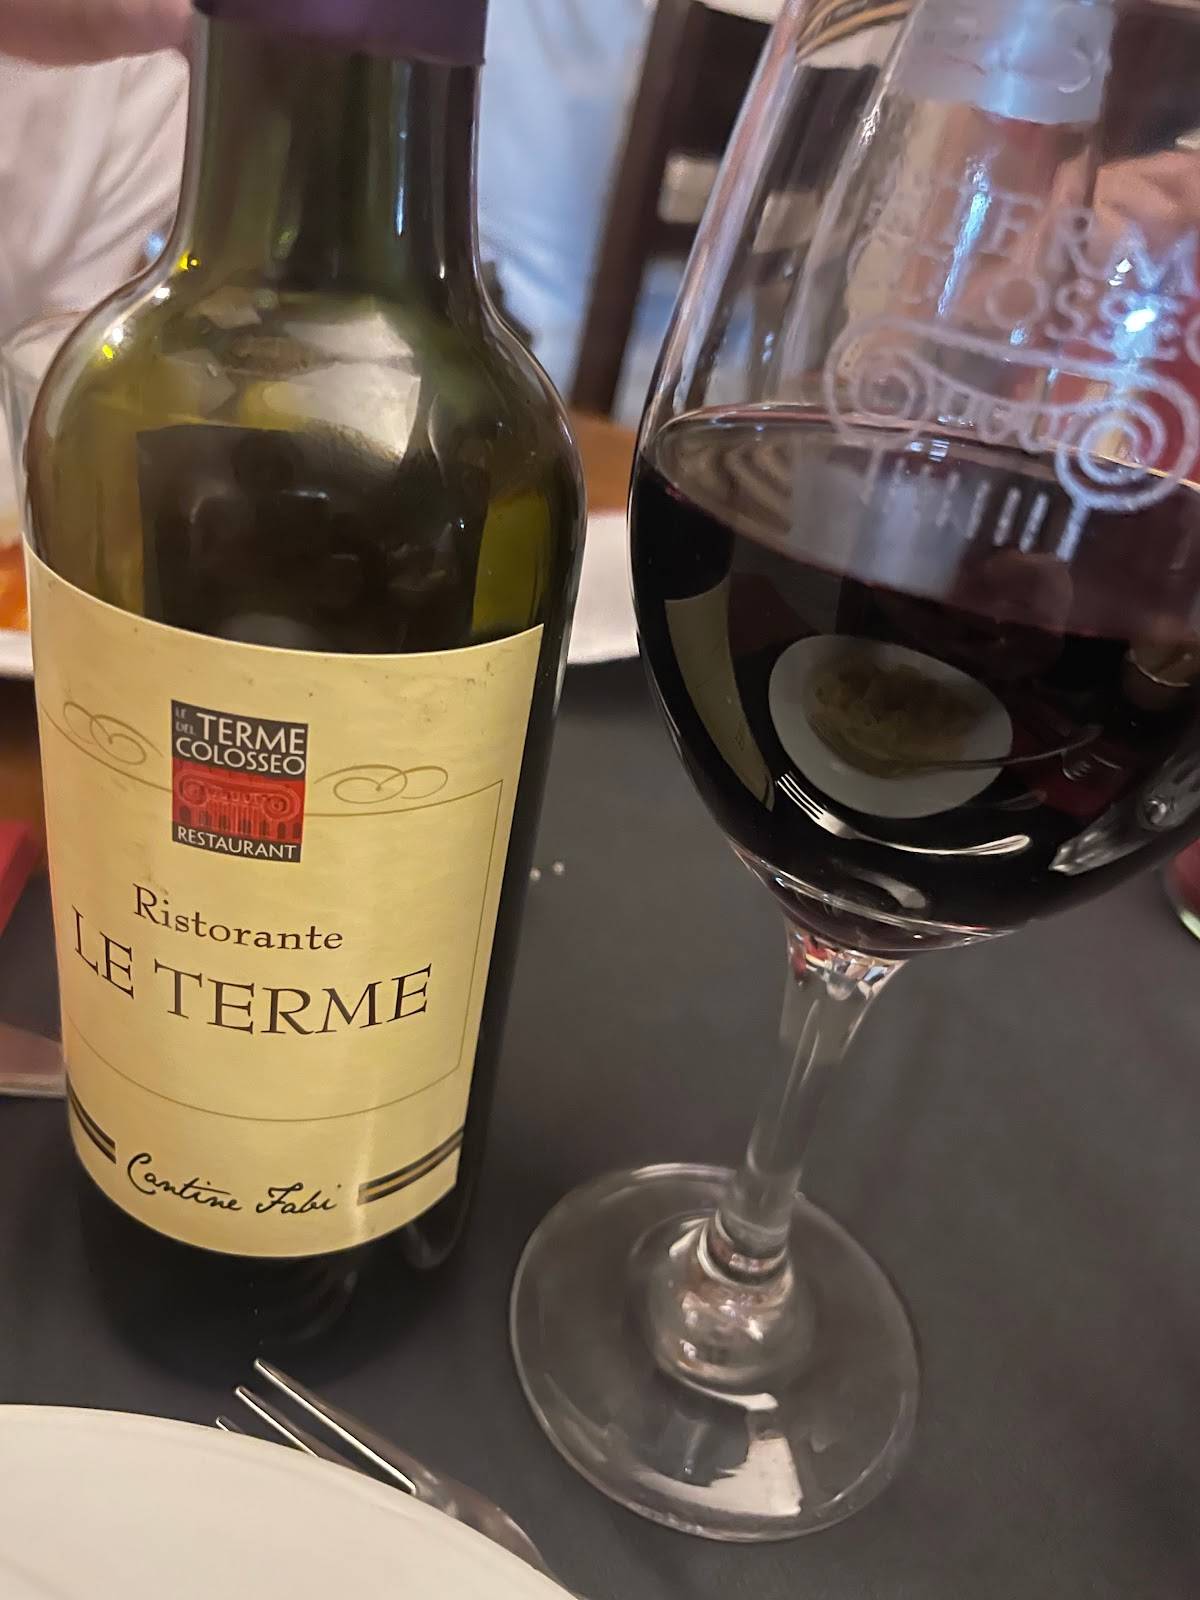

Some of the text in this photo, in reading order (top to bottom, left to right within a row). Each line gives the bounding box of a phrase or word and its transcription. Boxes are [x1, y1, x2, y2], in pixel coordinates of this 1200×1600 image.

[176, 737, 305, 775] COLOSSEO
[196, 712, 305, 755] TERME
[177, 825, 297, 860] RESTAURANT
[132, 883, 343, 950] Ristorante
[71, 904, 433, 1035] LE TERME
[126, 1152, 342, 1215] Cantine Fabi
